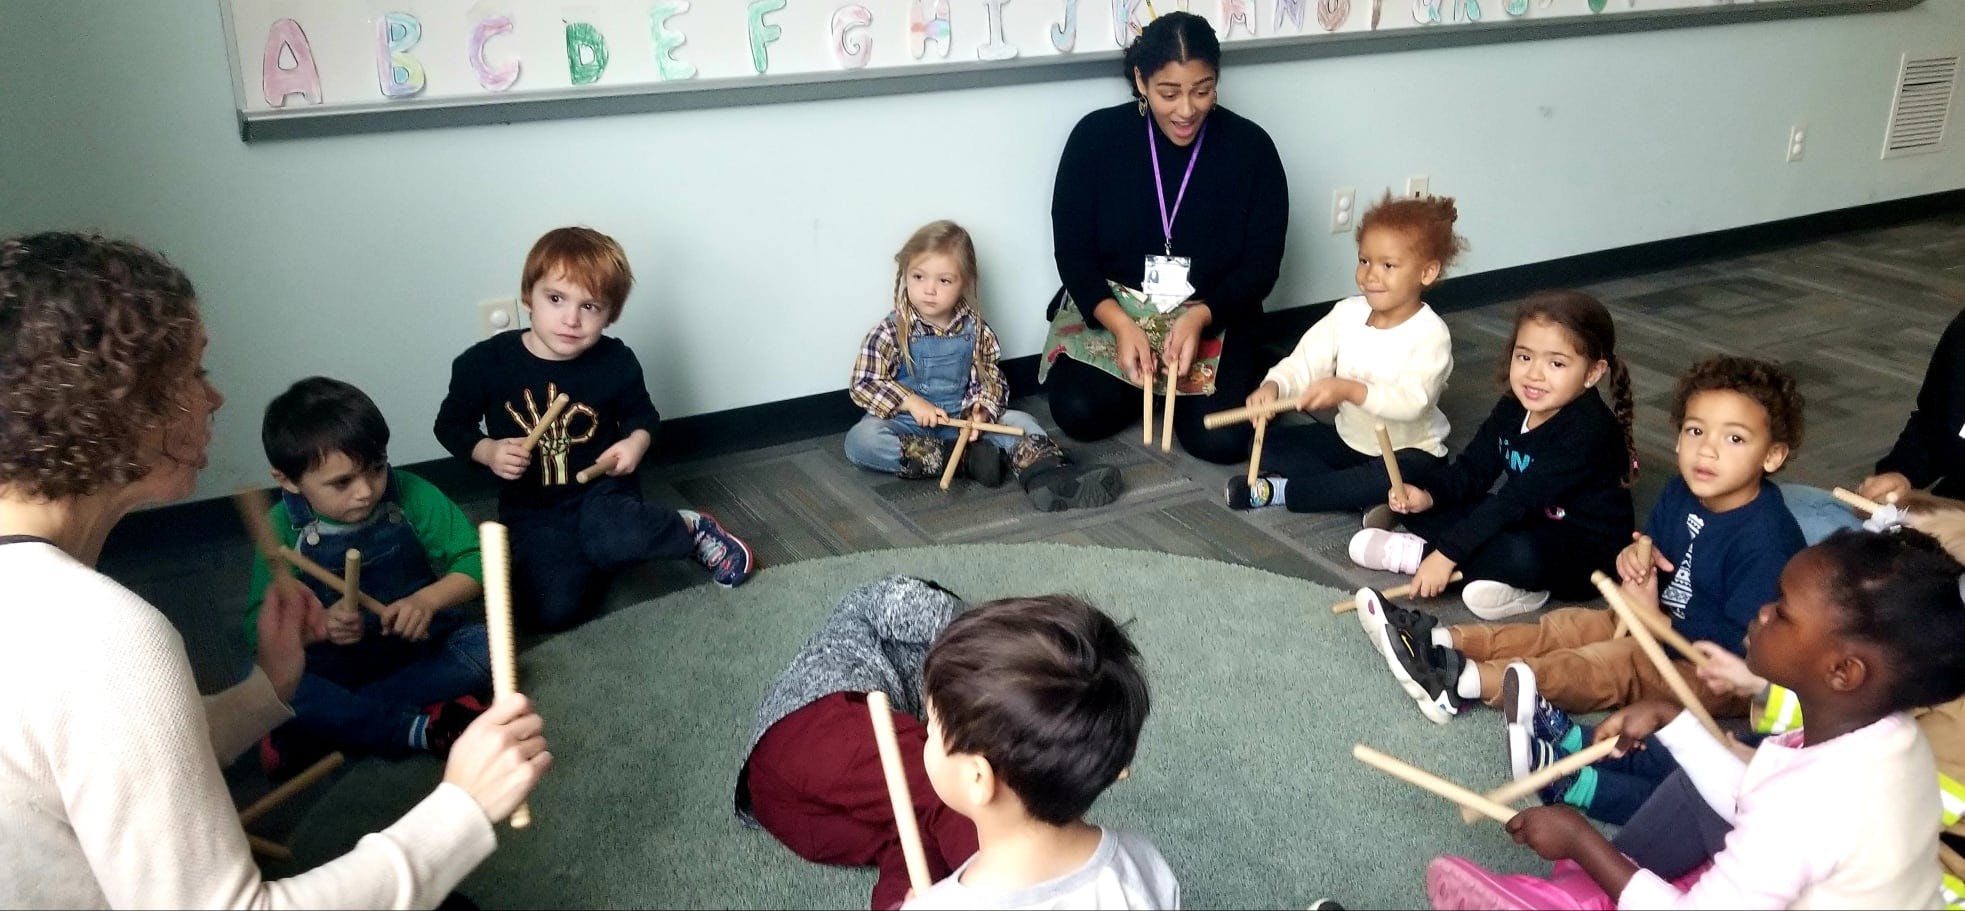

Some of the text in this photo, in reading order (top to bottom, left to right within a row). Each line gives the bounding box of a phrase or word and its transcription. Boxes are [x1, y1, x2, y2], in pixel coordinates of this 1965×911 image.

[262, 18, 323, 107] A
[376, 11, 427, 97] B
[469, 15, 520, 92] C
[565, 22, 608, 85] D
[650, 0, 697, 81] E
[748, 0, 787, 73] F
[831, 4, 873, 68] G
[909, 0, 951, 59] H
[977, 0, 1018, 60] I
[1050, 0, 1077, 52] J
